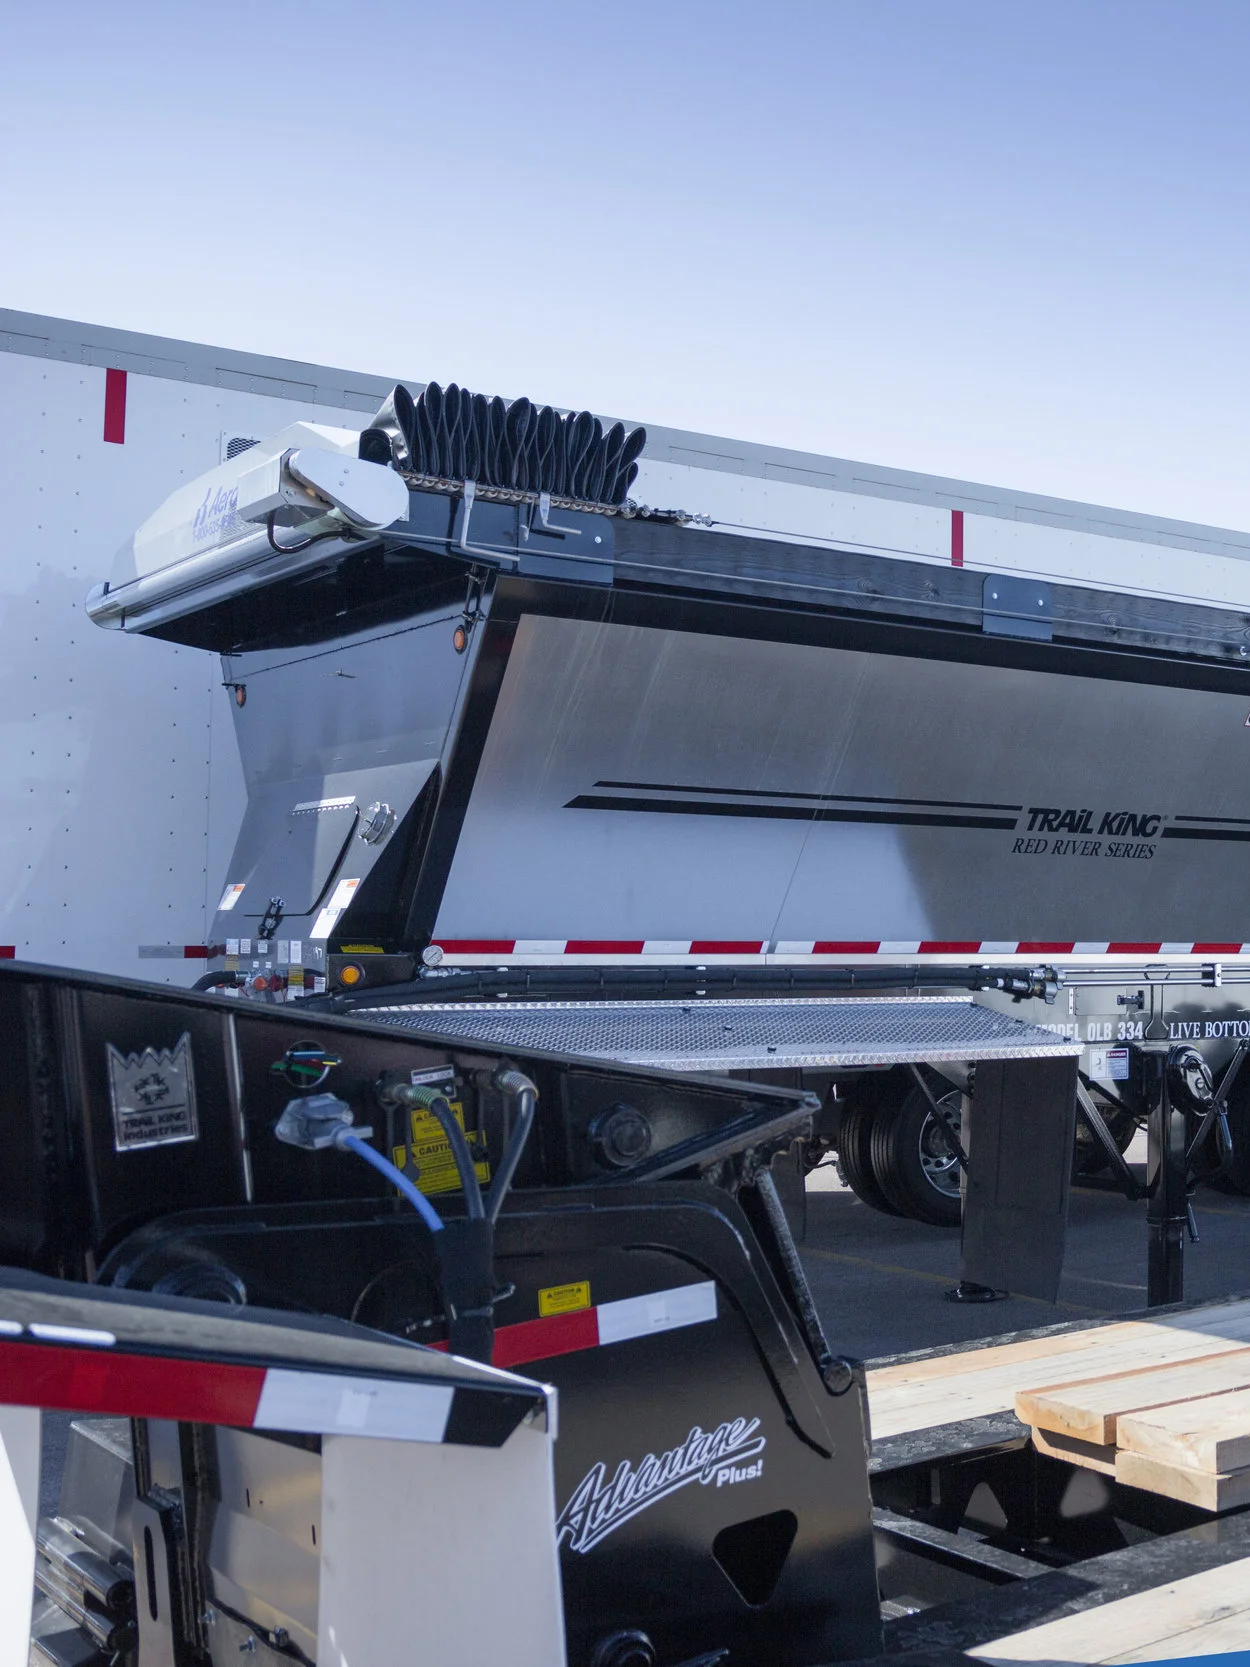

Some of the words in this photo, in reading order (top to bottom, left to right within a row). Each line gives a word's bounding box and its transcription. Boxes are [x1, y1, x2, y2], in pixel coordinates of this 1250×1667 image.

[1011, 837, 1048, 854] RED
[1051, 839, 1102, 857] RIVER
[1104, 842, 1157, 860] SERIES
[1117, 1021, 1144, 1041] 334
[1169, 1022, 1201, 1039] LIVE
[555, 1416, 765, 1553] Advantage
[716, 1459, 763, 1488] Plus!
